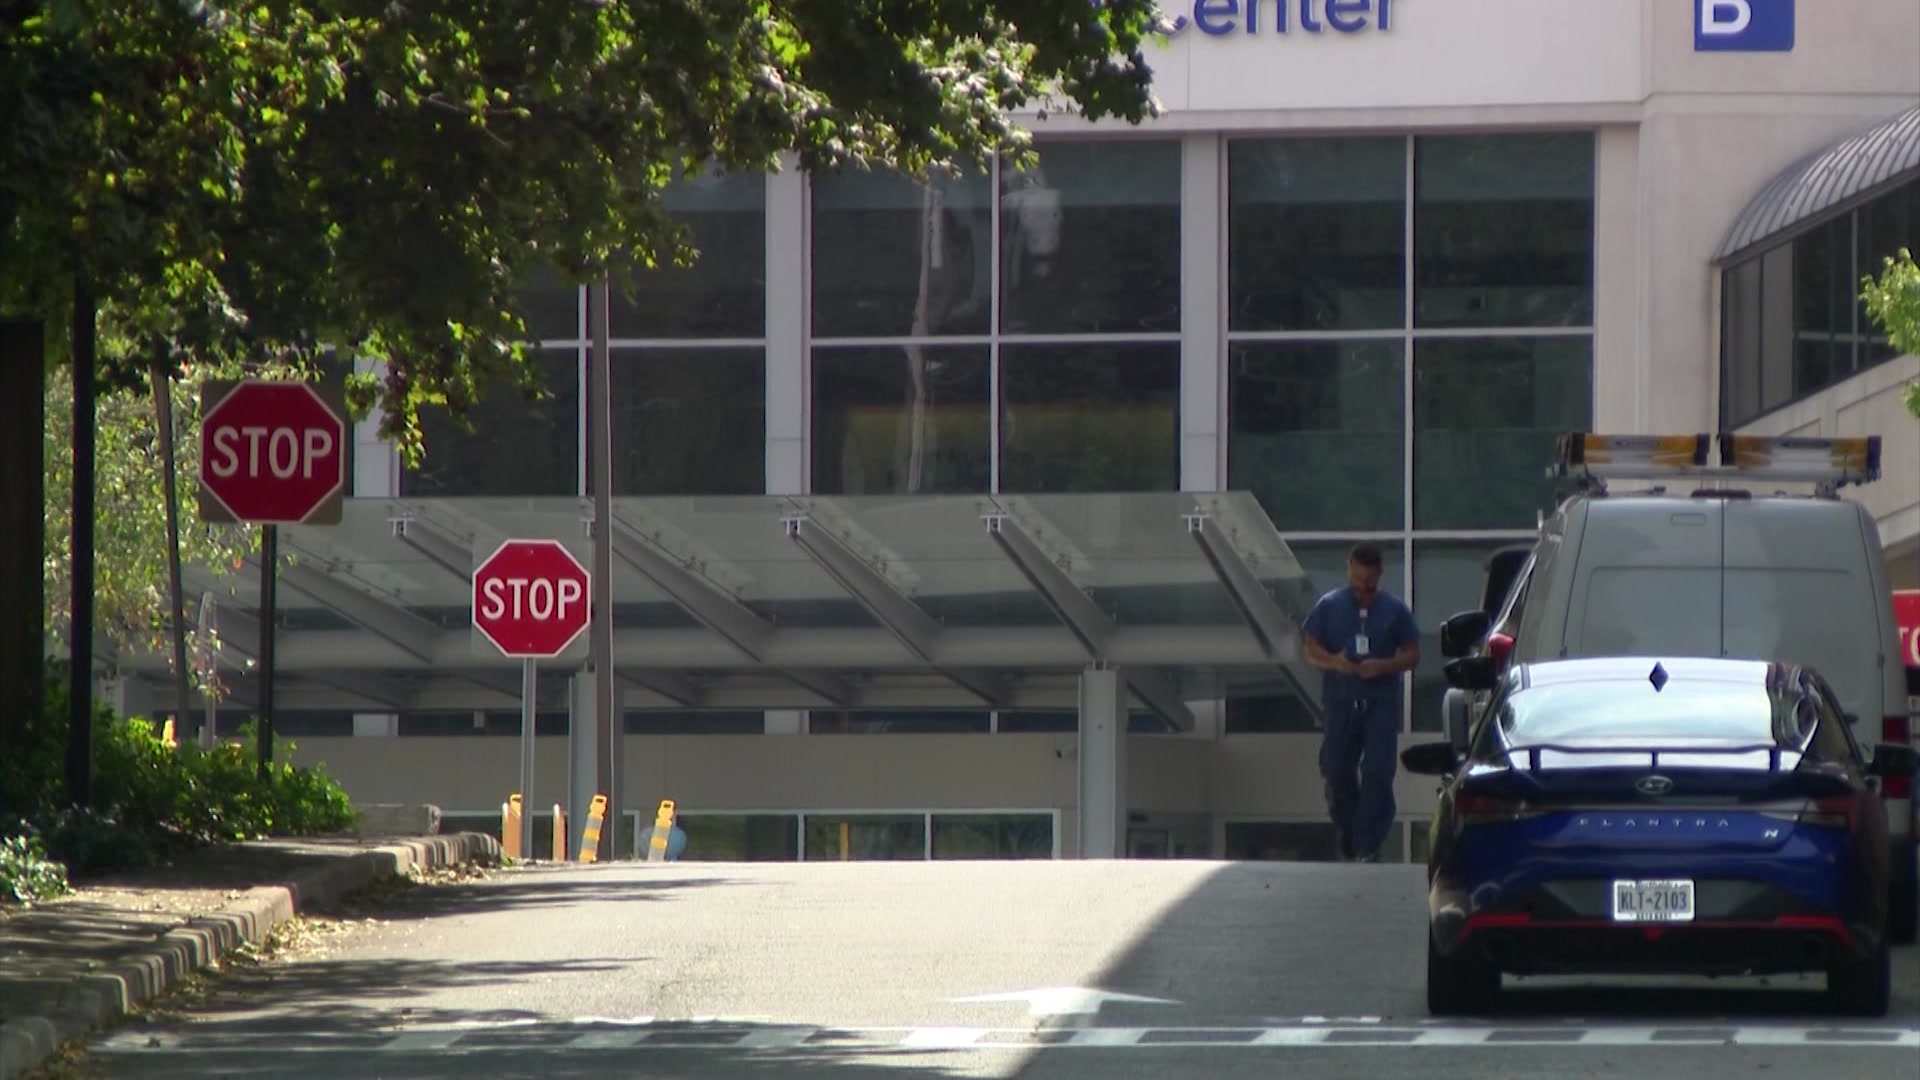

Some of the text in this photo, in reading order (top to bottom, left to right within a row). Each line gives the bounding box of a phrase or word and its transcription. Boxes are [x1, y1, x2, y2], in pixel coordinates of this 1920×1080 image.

[1156, 0, 1392, 36] enter
[210, 425, 333, 479] STOP
[481, 577, 582, 620] STOP
[1579, 817, 1729, 827] ELANTRA
